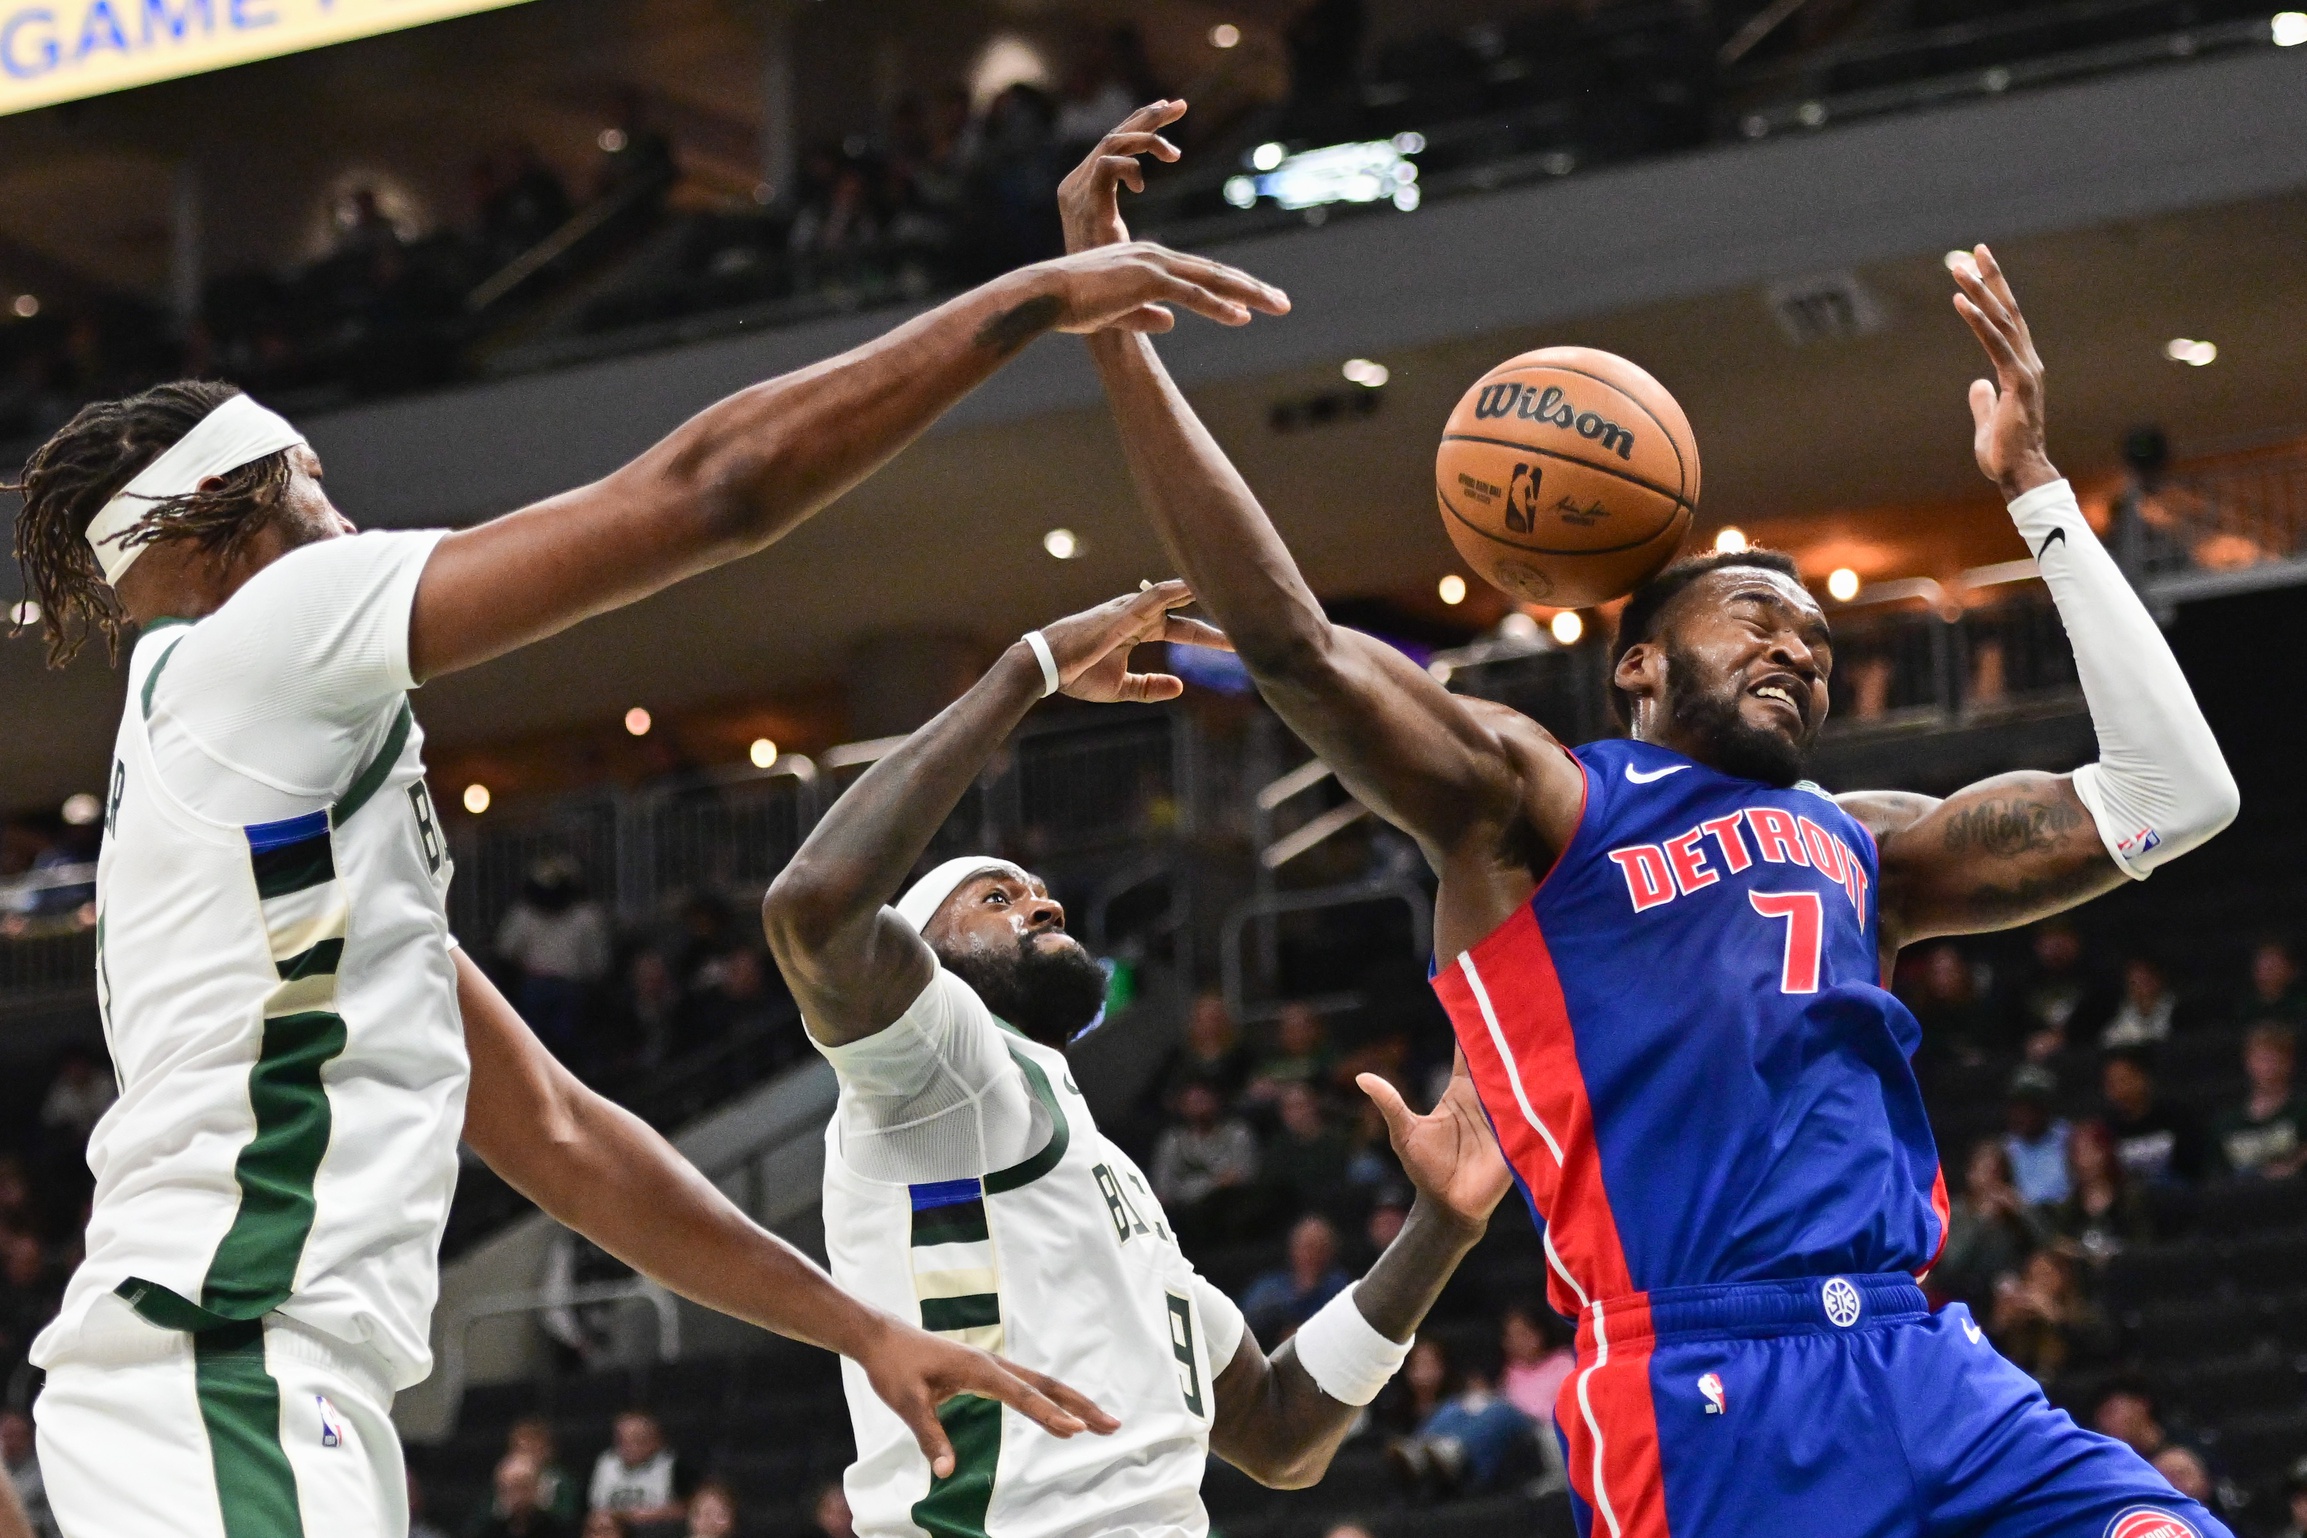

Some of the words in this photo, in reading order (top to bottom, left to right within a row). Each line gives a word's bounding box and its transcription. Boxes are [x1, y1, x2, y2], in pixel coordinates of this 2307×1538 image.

[1475, 383, 1635, 461] Wilson
[1608, 807, 1868, 937] DETROIT
[1749, 889, 1823, 994] 7
[1165, 1290, 1207, 1423] 9
